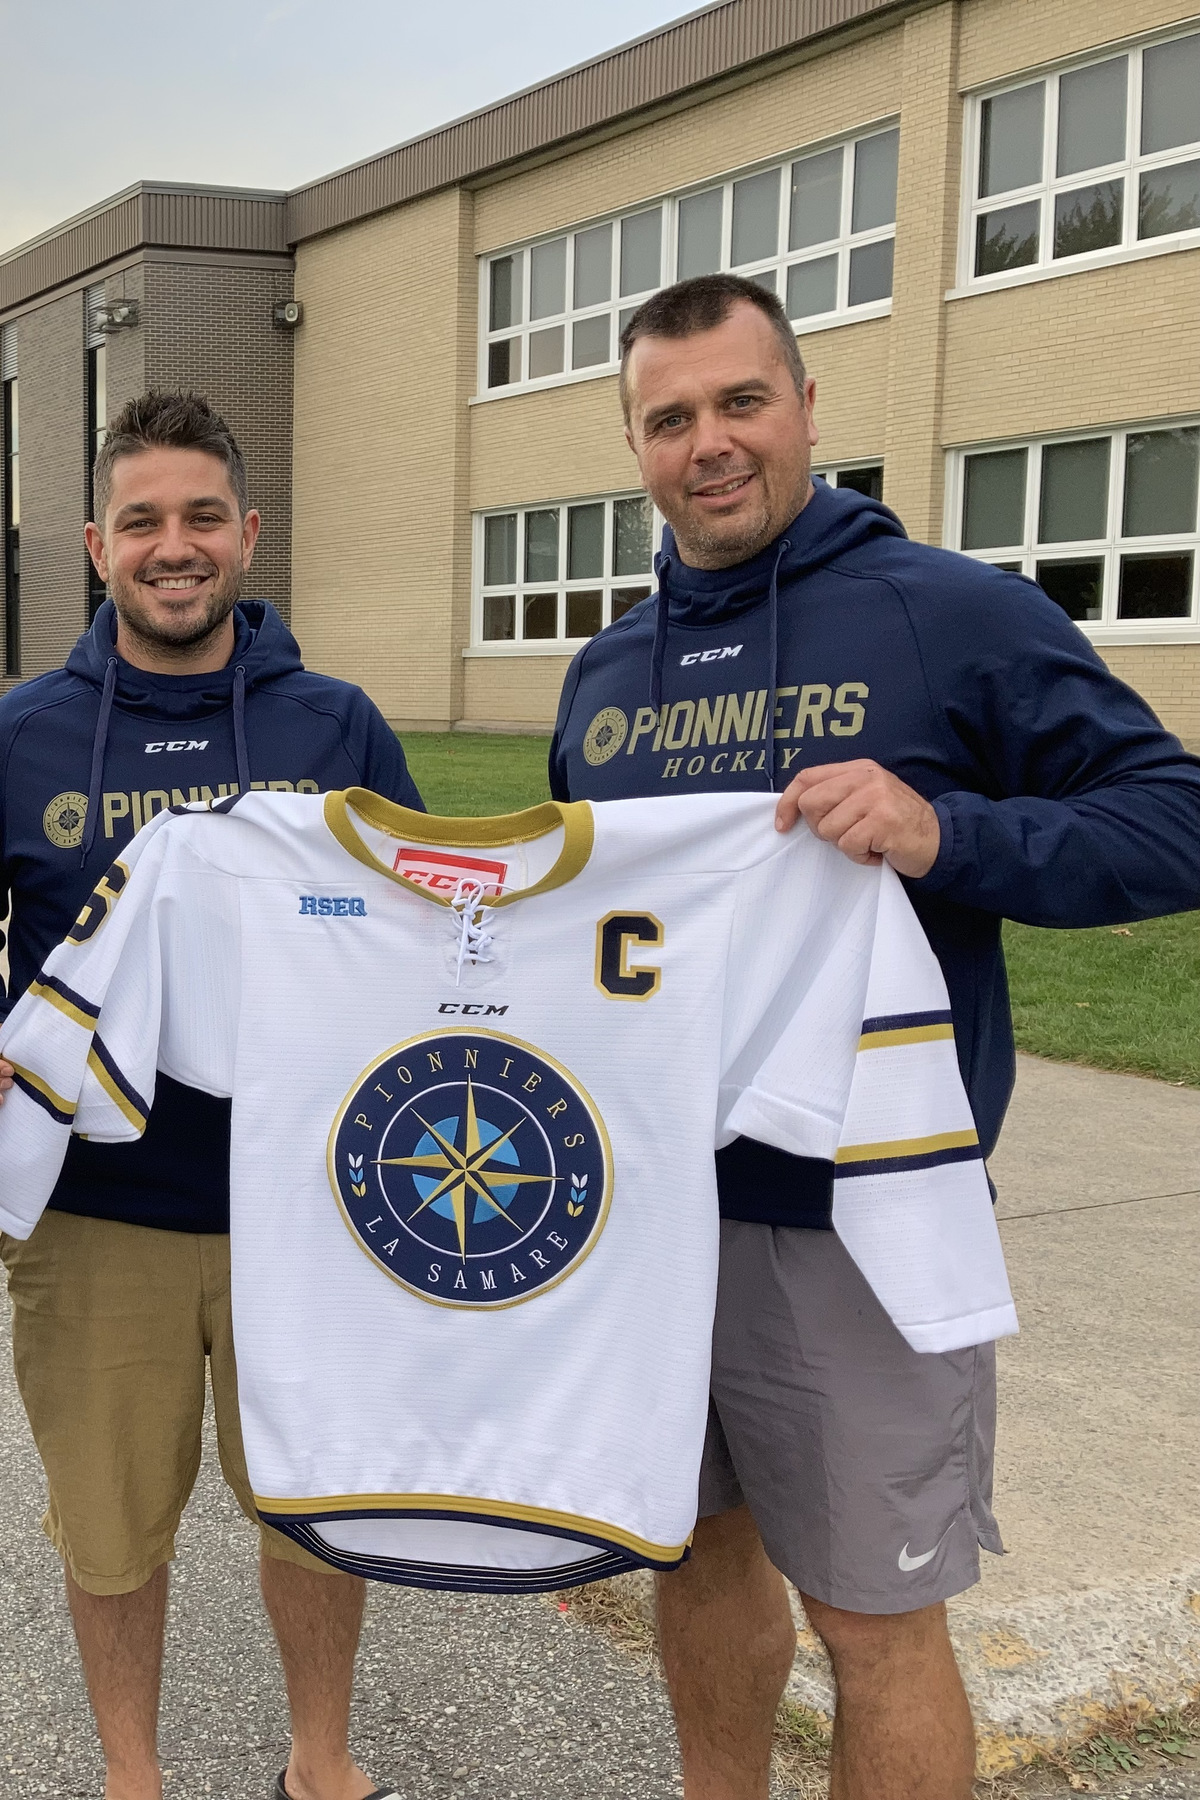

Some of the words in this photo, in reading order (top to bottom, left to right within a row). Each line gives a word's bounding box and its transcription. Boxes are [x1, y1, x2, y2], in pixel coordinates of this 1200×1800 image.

[680, 644, 743, 666] CCM
[626, 682, 869, 755] PIONNIERS
[144, 740, 209, 754] CCM
[299, 896, 368, 917] RSEQ
[595, 910, 664, 1001] C
[437, 1002, 510, 1016] CCM
[354, 1049, 585, 1148] PIONNIERS
[365, 1215, 400, 1256] LA
[427, 1231, 569, 1290] SAMARE
